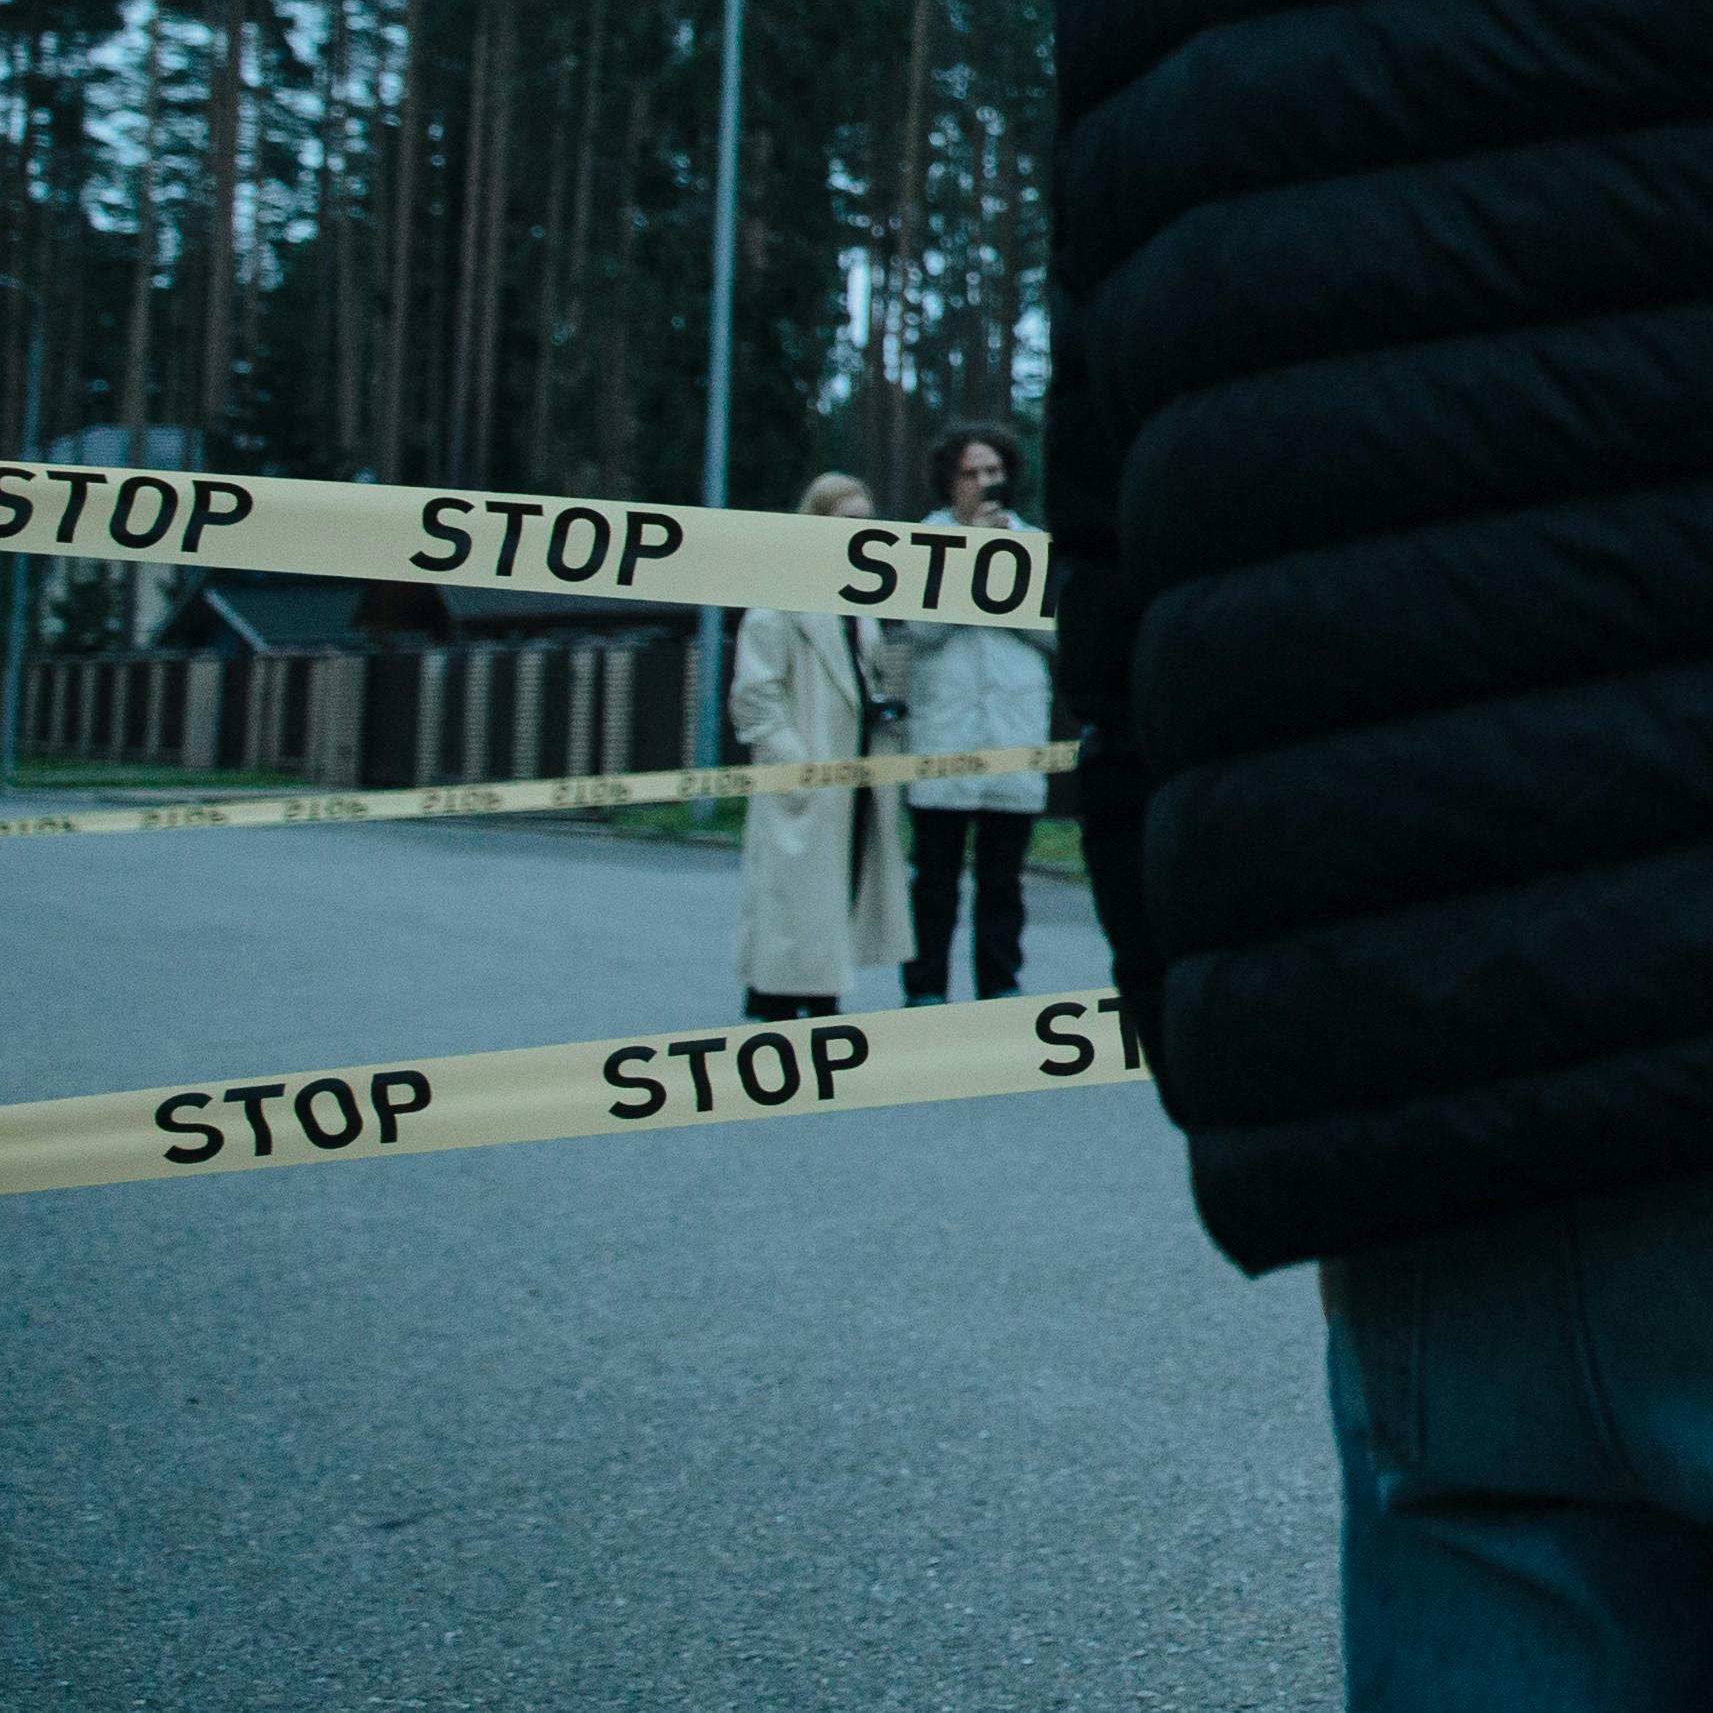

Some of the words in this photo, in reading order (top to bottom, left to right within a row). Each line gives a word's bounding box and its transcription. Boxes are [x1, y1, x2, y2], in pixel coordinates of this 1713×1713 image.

[0, 467, 253, 553] STOP
[409, 497, 683, 586] STOP
[155, 1070, 431, 1164] STOP
[603, 1025, 868, 1119] STOP
